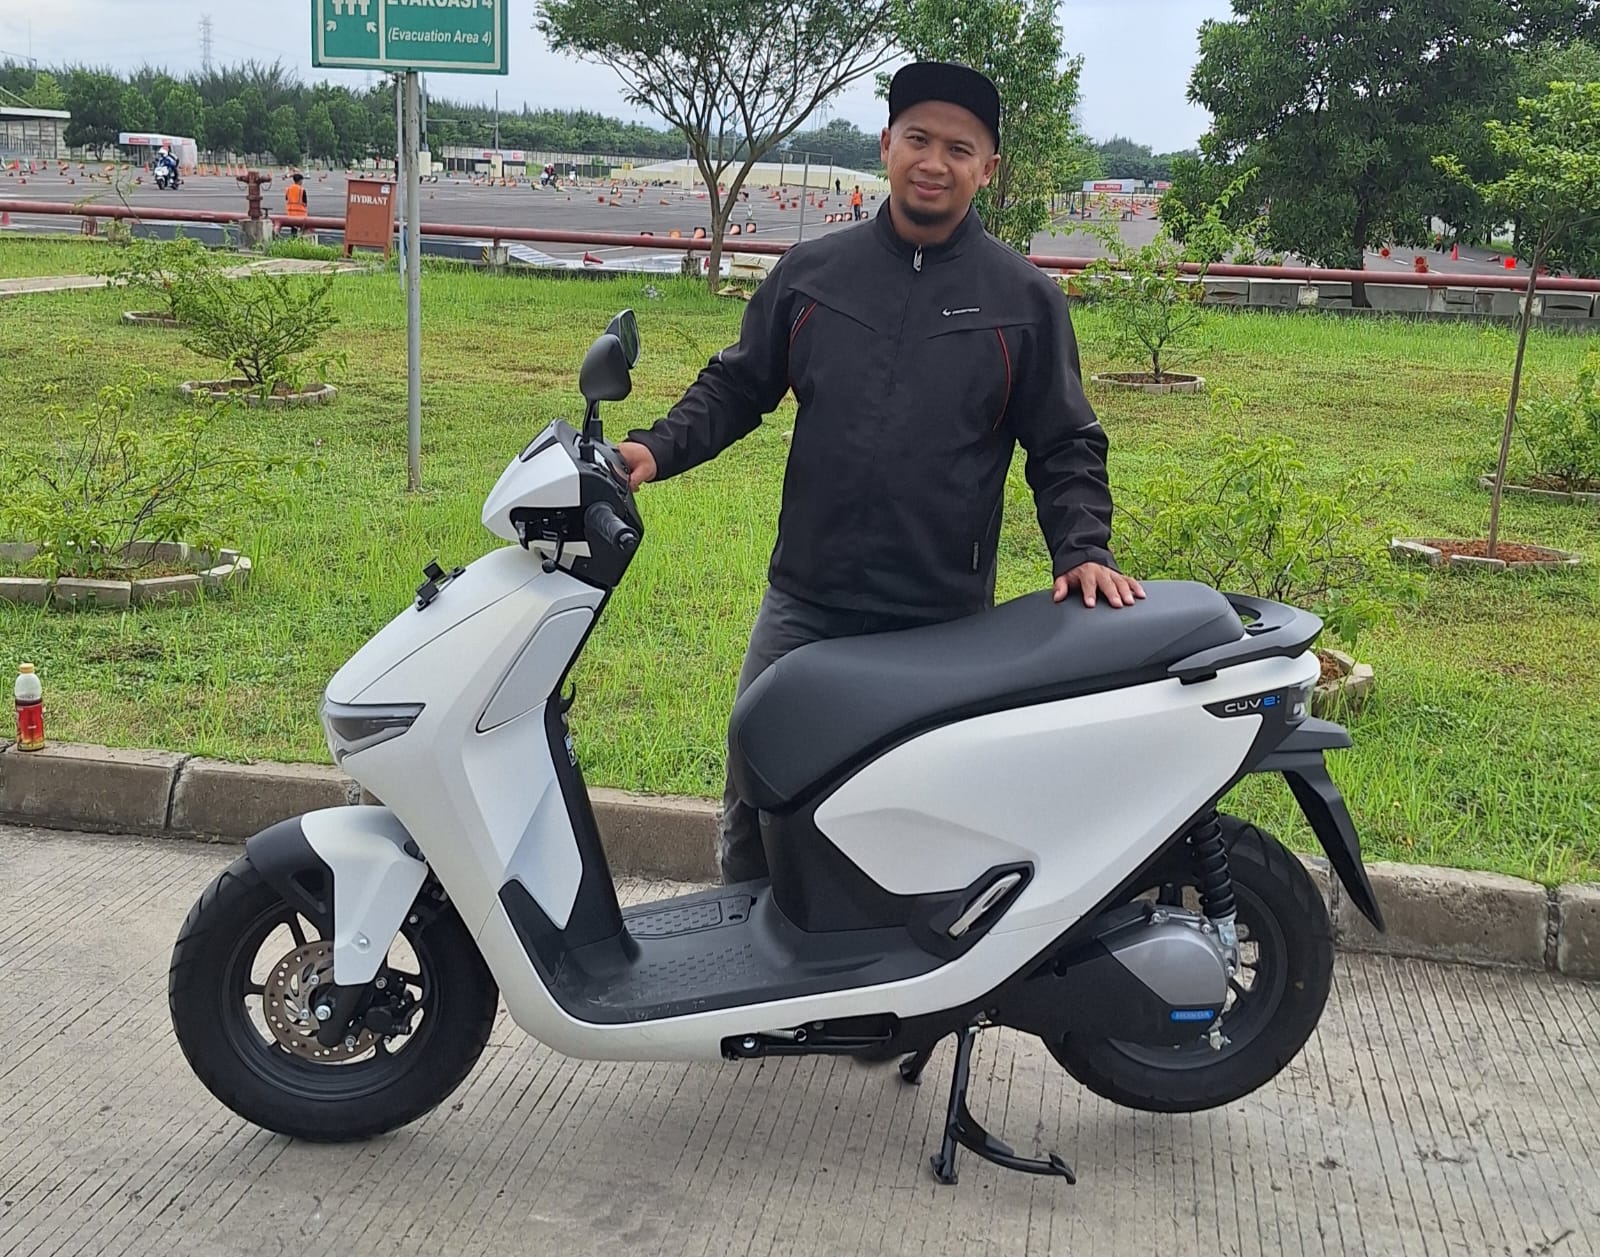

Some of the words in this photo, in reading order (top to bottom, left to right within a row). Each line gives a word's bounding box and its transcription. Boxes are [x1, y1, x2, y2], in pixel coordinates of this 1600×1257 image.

[387, 27, 451, 43] (Evacuation
[453, 29, 479, 44] Area
[481, 30, 492, 47] 4)
[350, 194, 388, 206] HYDRANT
